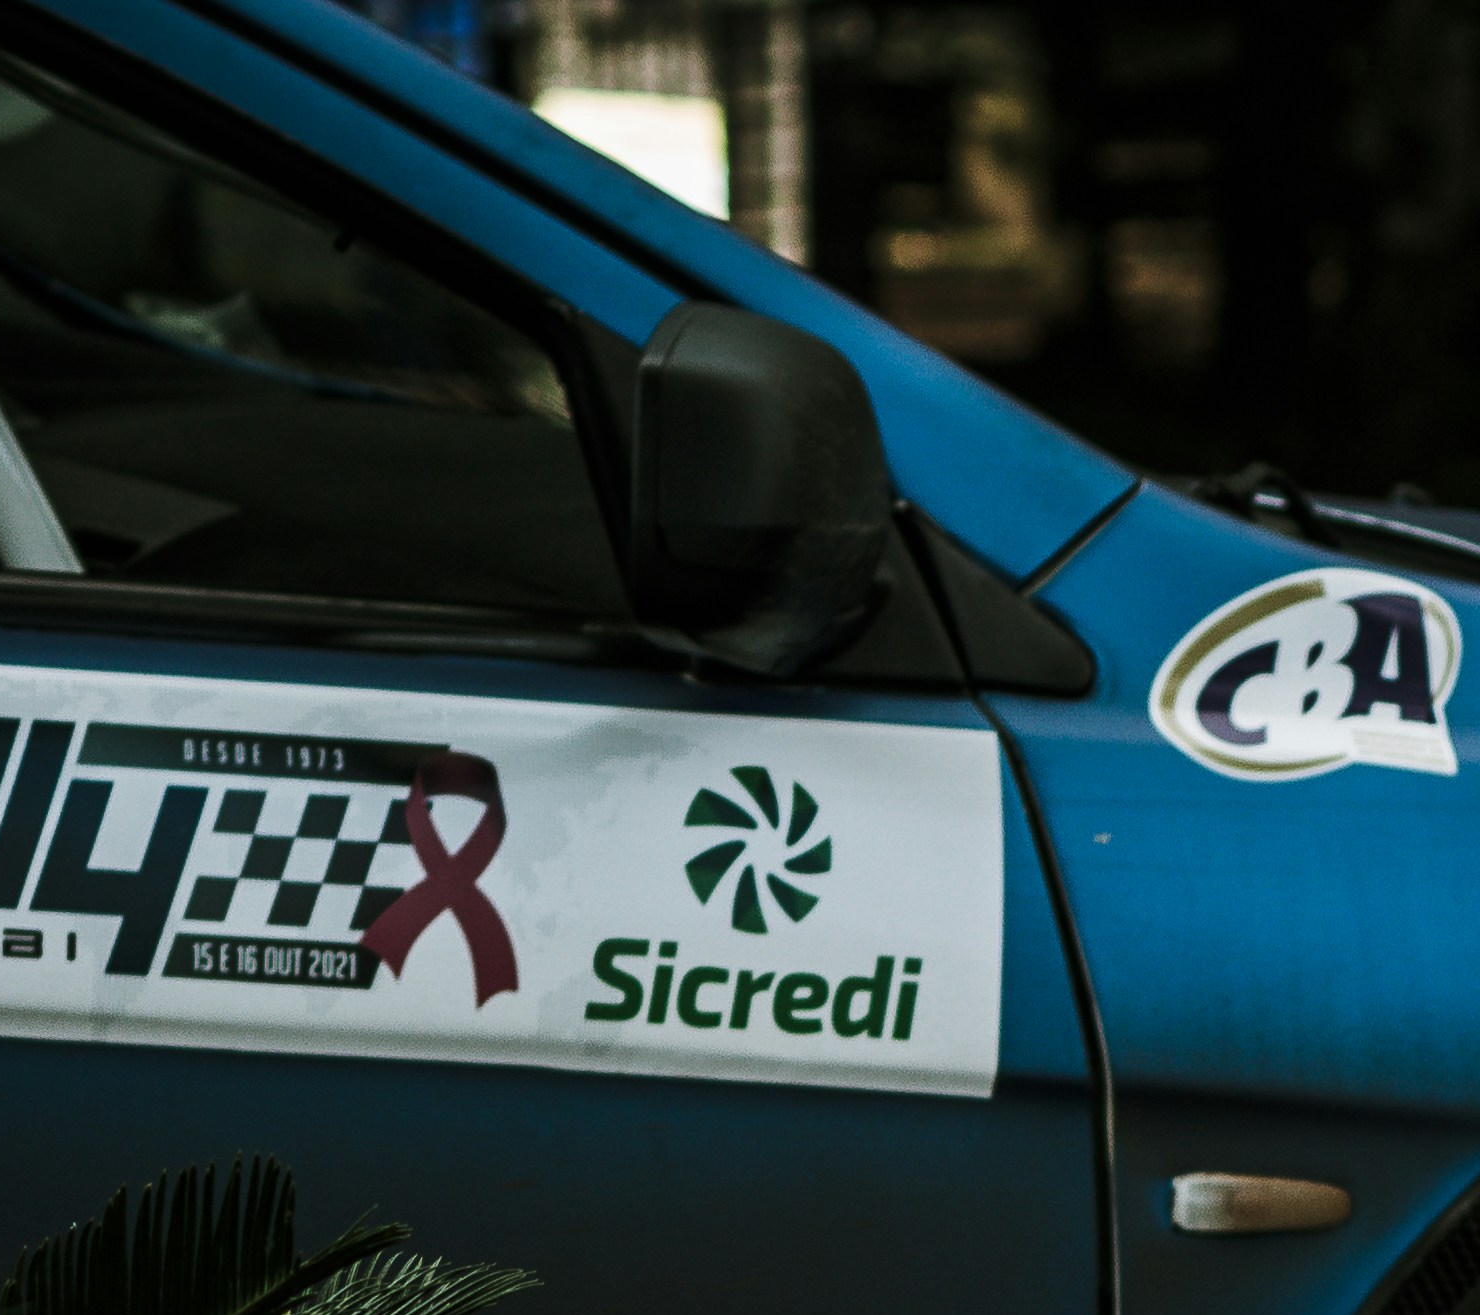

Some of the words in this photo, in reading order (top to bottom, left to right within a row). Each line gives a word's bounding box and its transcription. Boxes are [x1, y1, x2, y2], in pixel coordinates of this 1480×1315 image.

[1196, 592, 1437, 747] CBA
[182, 738, 263, 768] DESDE
[285, 745, 346, 772] 1973
[192, 942, 214, 972] 15
[219, 944, 230, 973] E
[237, 944, 259, 976] 16
[264, 946, 304, 978] OUT
[308, 949, 358, 981] 2021
[584, 937, 923, 1041] Sicredi
